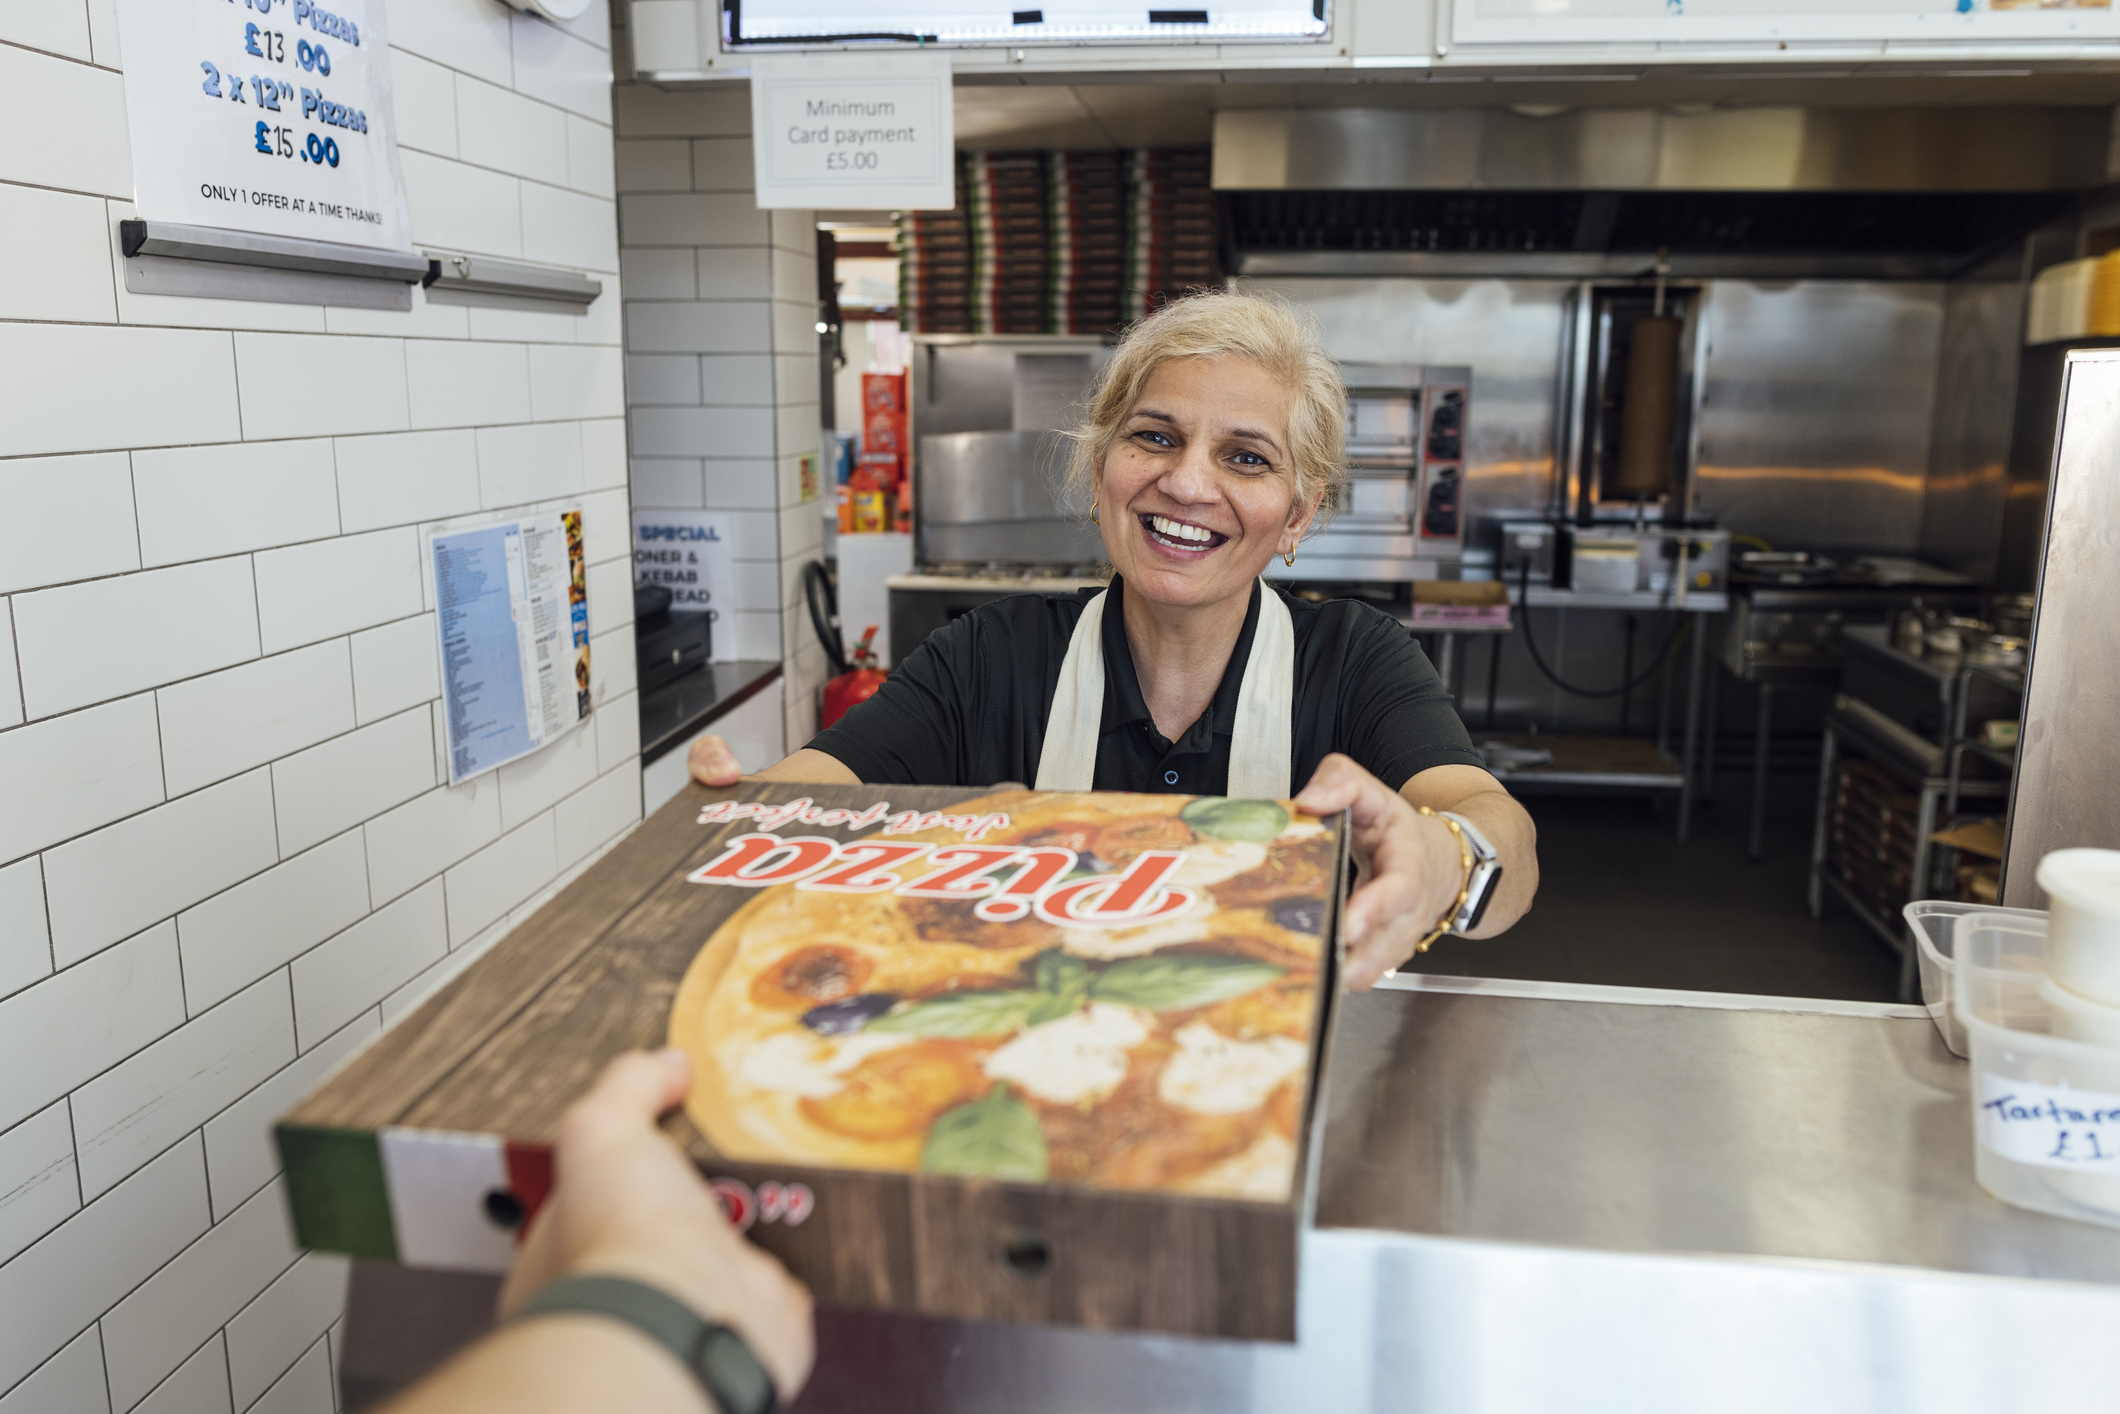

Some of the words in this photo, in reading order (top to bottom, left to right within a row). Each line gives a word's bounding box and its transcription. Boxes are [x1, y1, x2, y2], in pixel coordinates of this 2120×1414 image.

[293, 0, 360, 47] Pizzas
[200, 61, 222, 98] 2
[227, 73, 246, 105] x
[300, 87, 368, 134] Pizzas
[806, 99, 895, 117] Minimum
[787, 125, 829, 144] Card
[834, 127, 915, 146] payment
[827, 151, 879, 170] £5.00
[201, 184, 238, 203] ONLY
[241, 190, 247, 203] 1
[251, 191, 289, 210] OFFER
[292, 197, 305, 213] AT
[308, 201, 317, 214] A
[319, 202, 343, 219] TIME
[639, 525, 720, 542] SPECIAL
[635, 548, 682, 565] ONER
[641, 569, 699, 584] KEBAB
[672, 588, 711, 603] EAD
[695, 797, 890, 834] perfect
[687, 831, 1197, 930] Pizza
